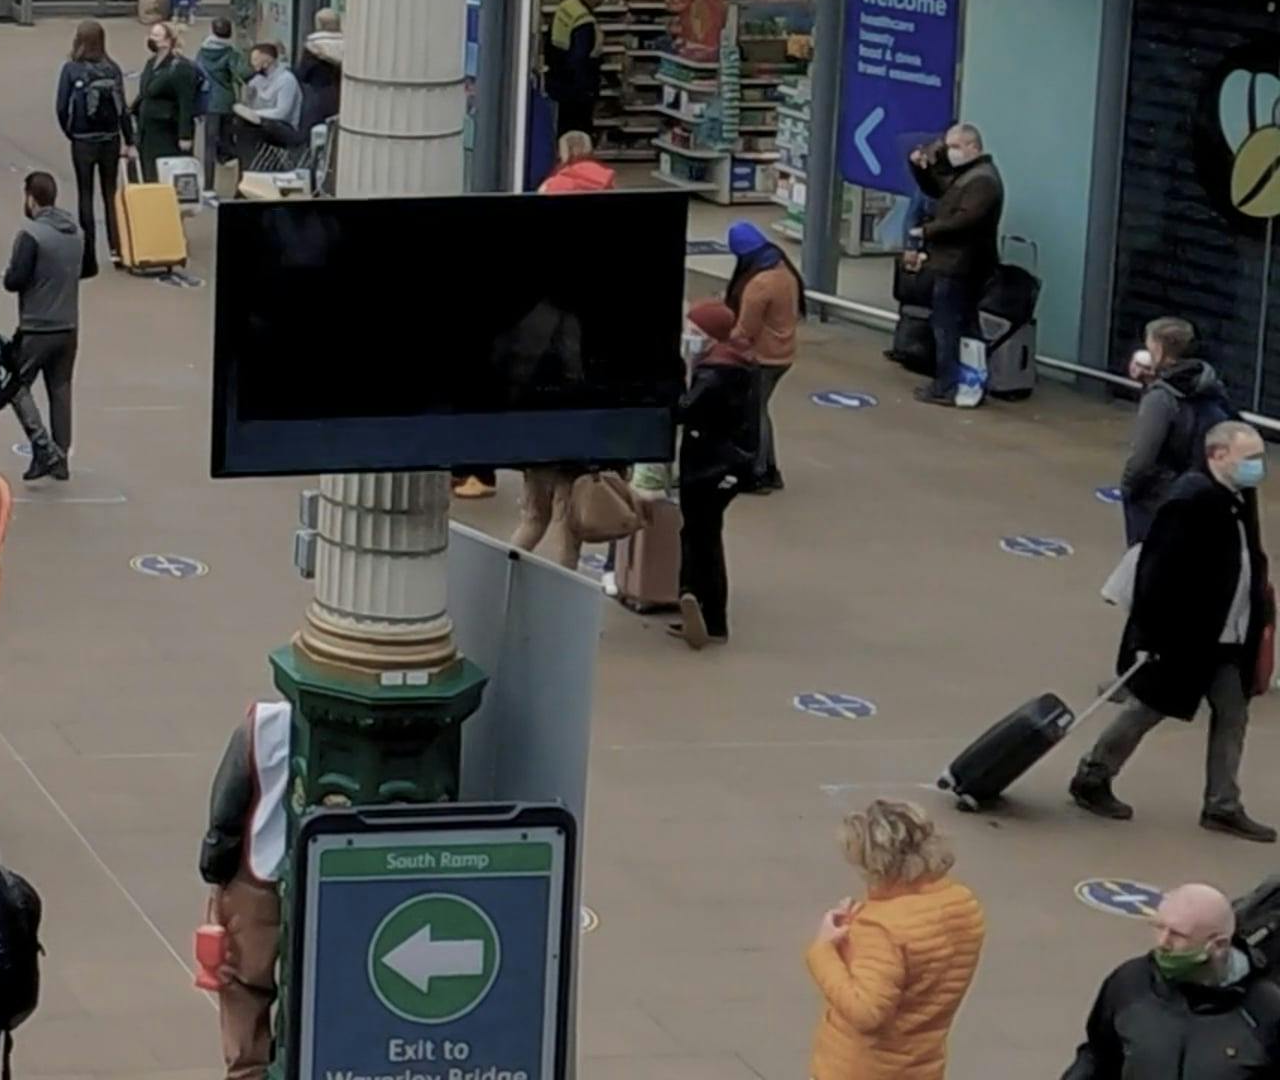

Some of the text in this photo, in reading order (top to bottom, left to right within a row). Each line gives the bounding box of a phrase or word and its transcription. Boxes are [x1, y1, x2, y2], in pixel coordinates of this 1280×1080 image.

[860, 12, 915, 32] healthcare
[858, 44, 882, 60] food
[894, 51, 922, 66] drink
[858, 60, 942, 88] travel essentials
[386, 852, 490, 870] South Ramp
[389, 1038, 470, 1062] Exit to
